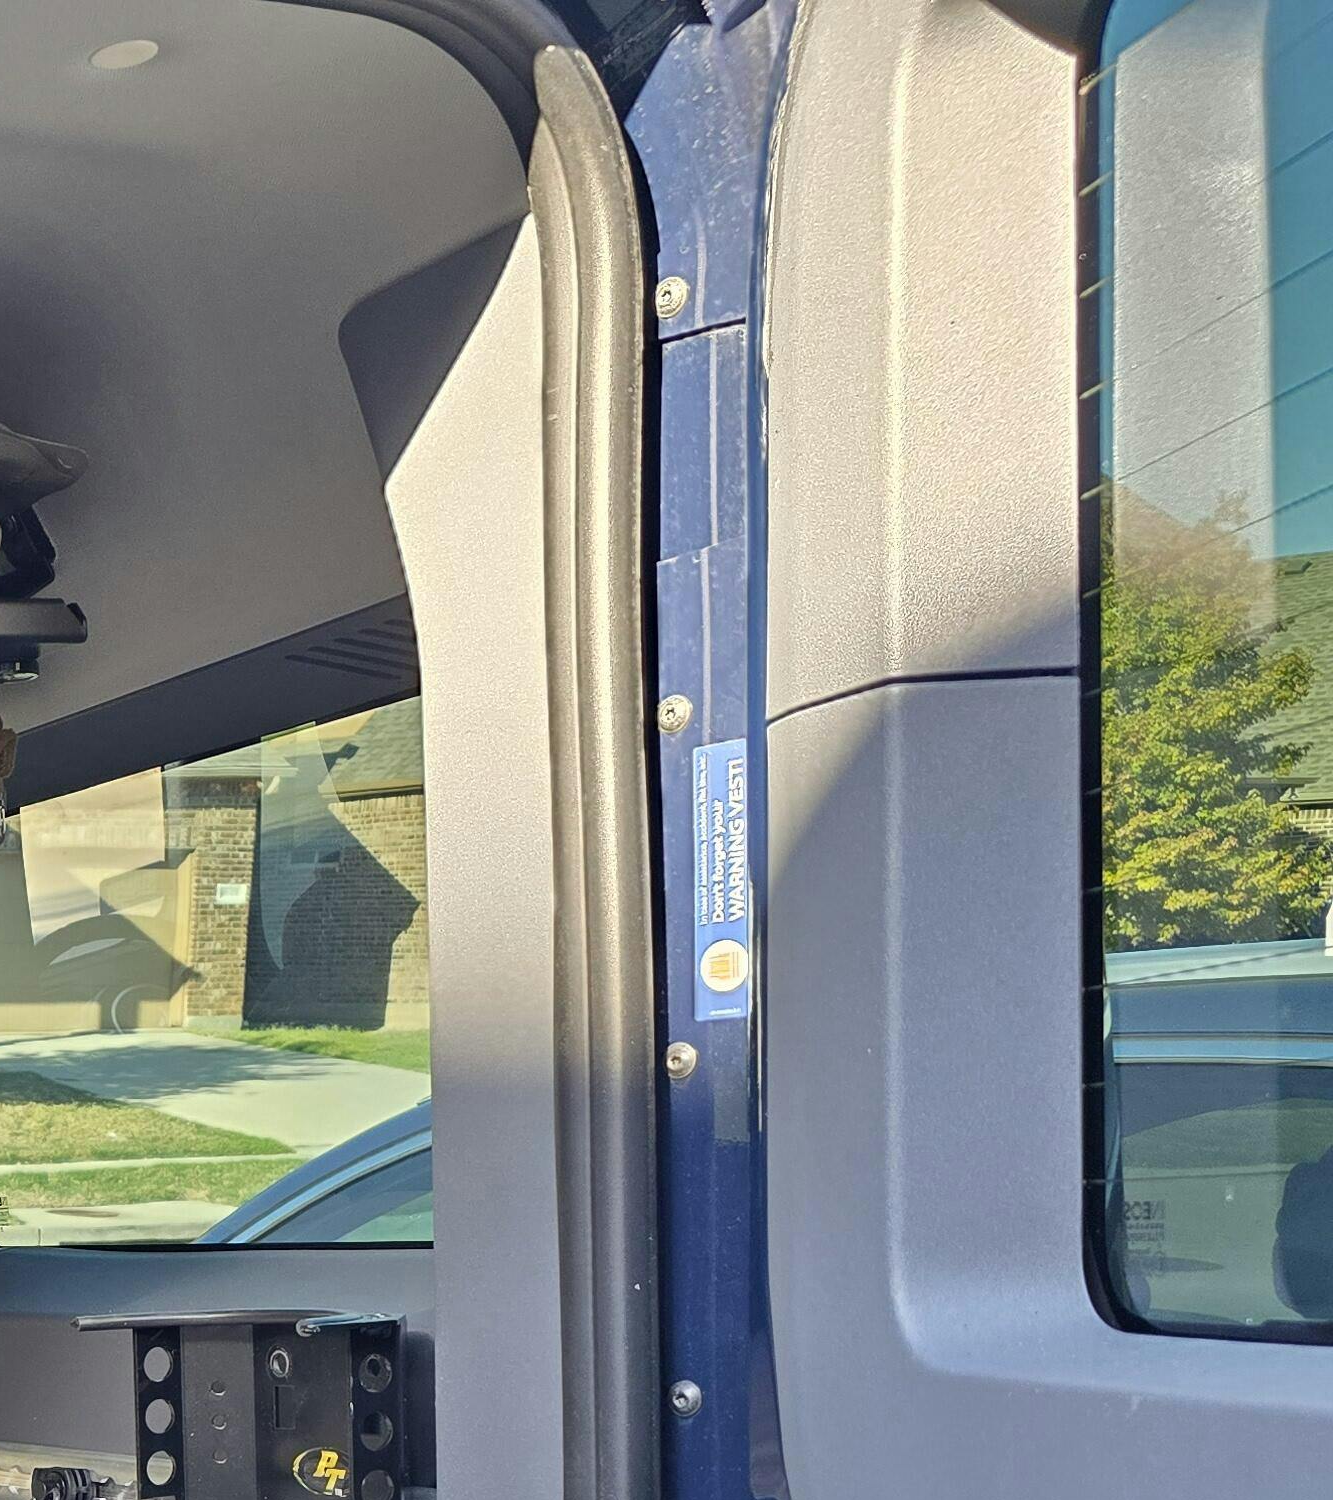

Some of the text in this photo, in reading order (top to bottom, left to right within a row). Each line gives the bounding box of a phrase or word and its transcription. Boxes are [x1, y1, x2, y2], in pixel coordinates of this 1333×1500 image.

[712, 800, 727, 834] your
[711, 836, 727, 881] forget
[727, 818, 746, 922] WARNING
[313, 1449, 347, 1492] PT
